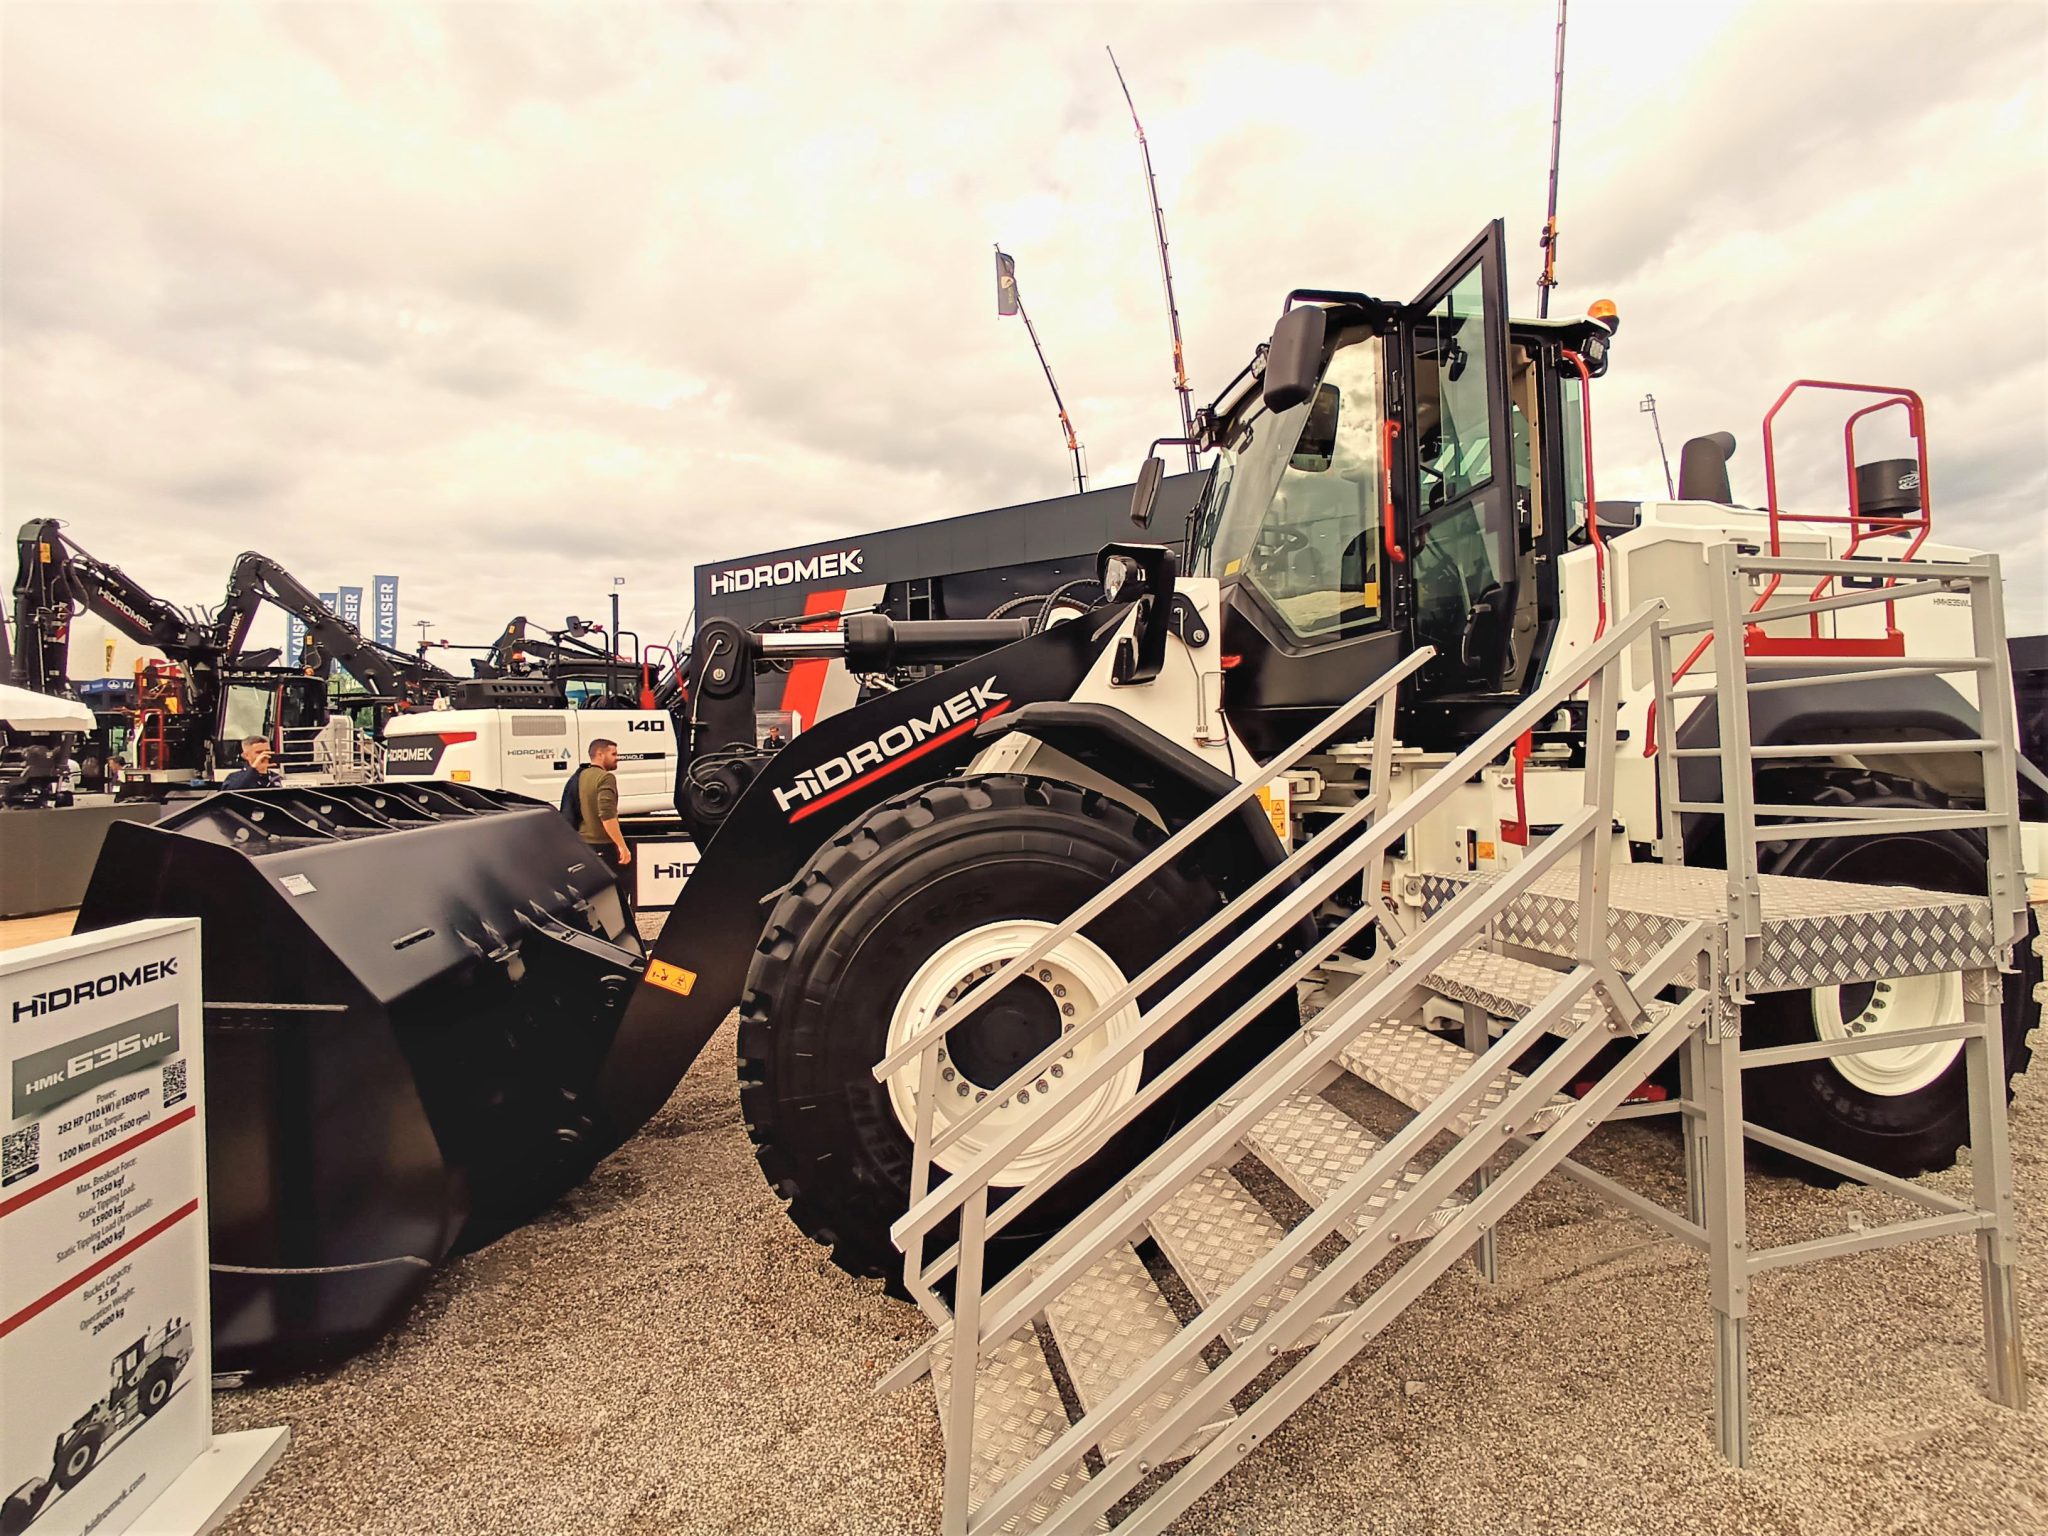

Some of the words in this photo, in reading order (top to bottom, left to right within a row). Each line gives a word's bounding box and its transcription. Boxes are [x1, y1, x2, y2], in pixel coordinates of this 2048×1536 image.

[380, 583, 393, 638] KAISER
[628, 720, 665, 732] 140
[96, 1090, 117, 1104] Power:
[58, 1121, 72, 1135] 282
[73, 1116, 84, 1128] HP
[84, 1108, 100, 1123] (210
[101, 1101, 115, 1115] kW)
[137, 1088, 150, 1100] rpm
[58, 1147, 77, 1163] 1200
[78, 1142, 91, 1154] Nm
[136, 1110, 151, 1125] rpm)
[88, 1122, 103, 1135] Max.
[76, 1183, 92, 1195] Max.
[93, 1166, 120, 1186] Breakout
[91, 1182, 113, 1200] 17650
[113, 1174, 125, 1189] kgf
[78, 1206, 96, 1222] Static
[97, 1193, 120, 1211] Tipping
[91, 1208, 113, 1227] 15900
[113, 1200, 125, 1214] kgf
[56, 1245, 76, 1263] Static
[76, 1230, 101, 1250] Tipping
[101, 1218, 117, 1235] Load
[91, 1234, 113, 1255] 14000
[114, 1225, 126, 1241] kgf
[83, 1280, 106, 1301] Bucket
[80, 1303, 112, 1331] Operation
